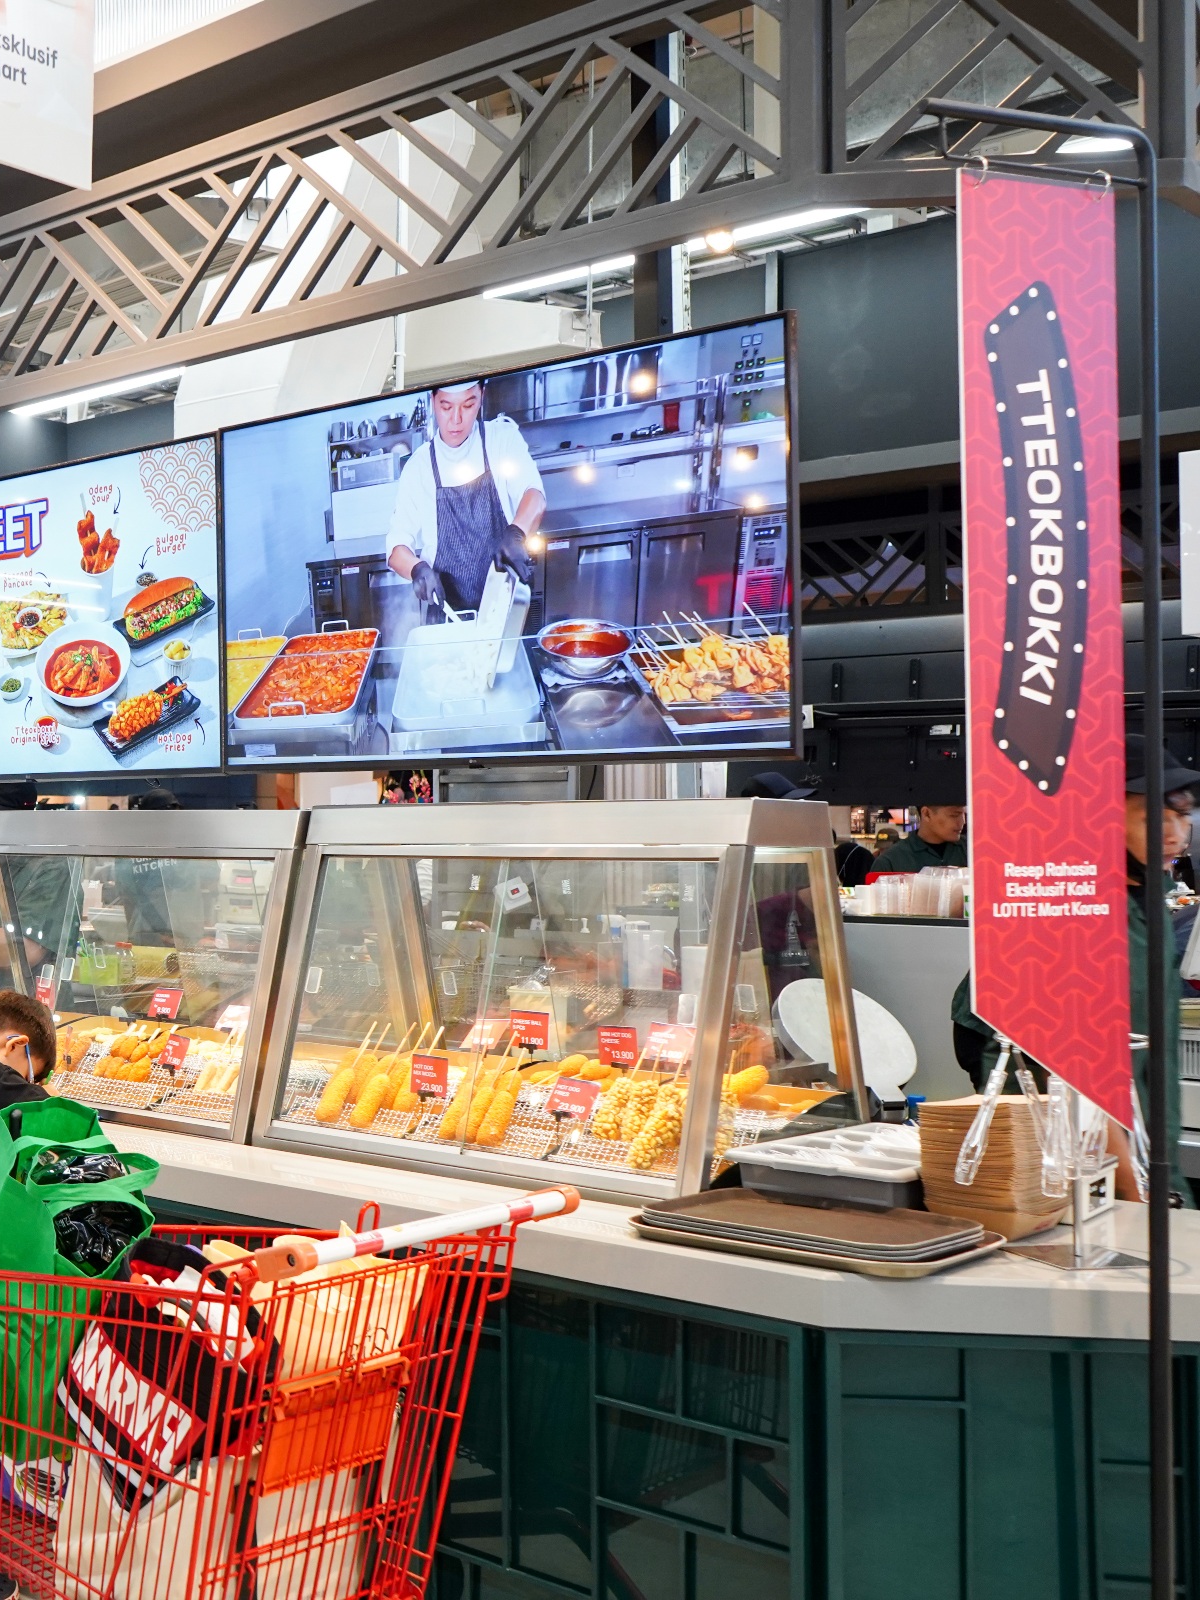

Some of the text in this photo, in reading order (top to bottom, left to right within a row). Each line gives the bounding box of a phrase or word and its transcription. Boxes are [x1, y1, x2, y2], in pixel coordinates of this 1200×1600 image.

[88, 484, 113, 496] Odeng
[91, 494, 110, 506] Soup
[156, 533, 187, 546] Bulgogi
[1015, 368, 1064, 706] TTEOKBOKKI
[157, 542, 187, 556] Burger
[10, 733, 40, 746] Original
[158, 733, 192, 744] Hot Dog
[132, 858, 178, 874] KITCHEN
[1004, 860, 1098, 880] Resep Rahasia
[1005, 880, 1096, 897] Eksklusif Koki
[992, 902, 1110, 918] LOTTE Mart Korea
[520, 1036, 544, 1046] 11.900
[611, 1050, 634, 1060] 13.900
[421, 1082, 443, 1093] 23.900
[557, 1101, 586, 1114] 23.900
[70, 1324, 193, 1475] MARVEL
